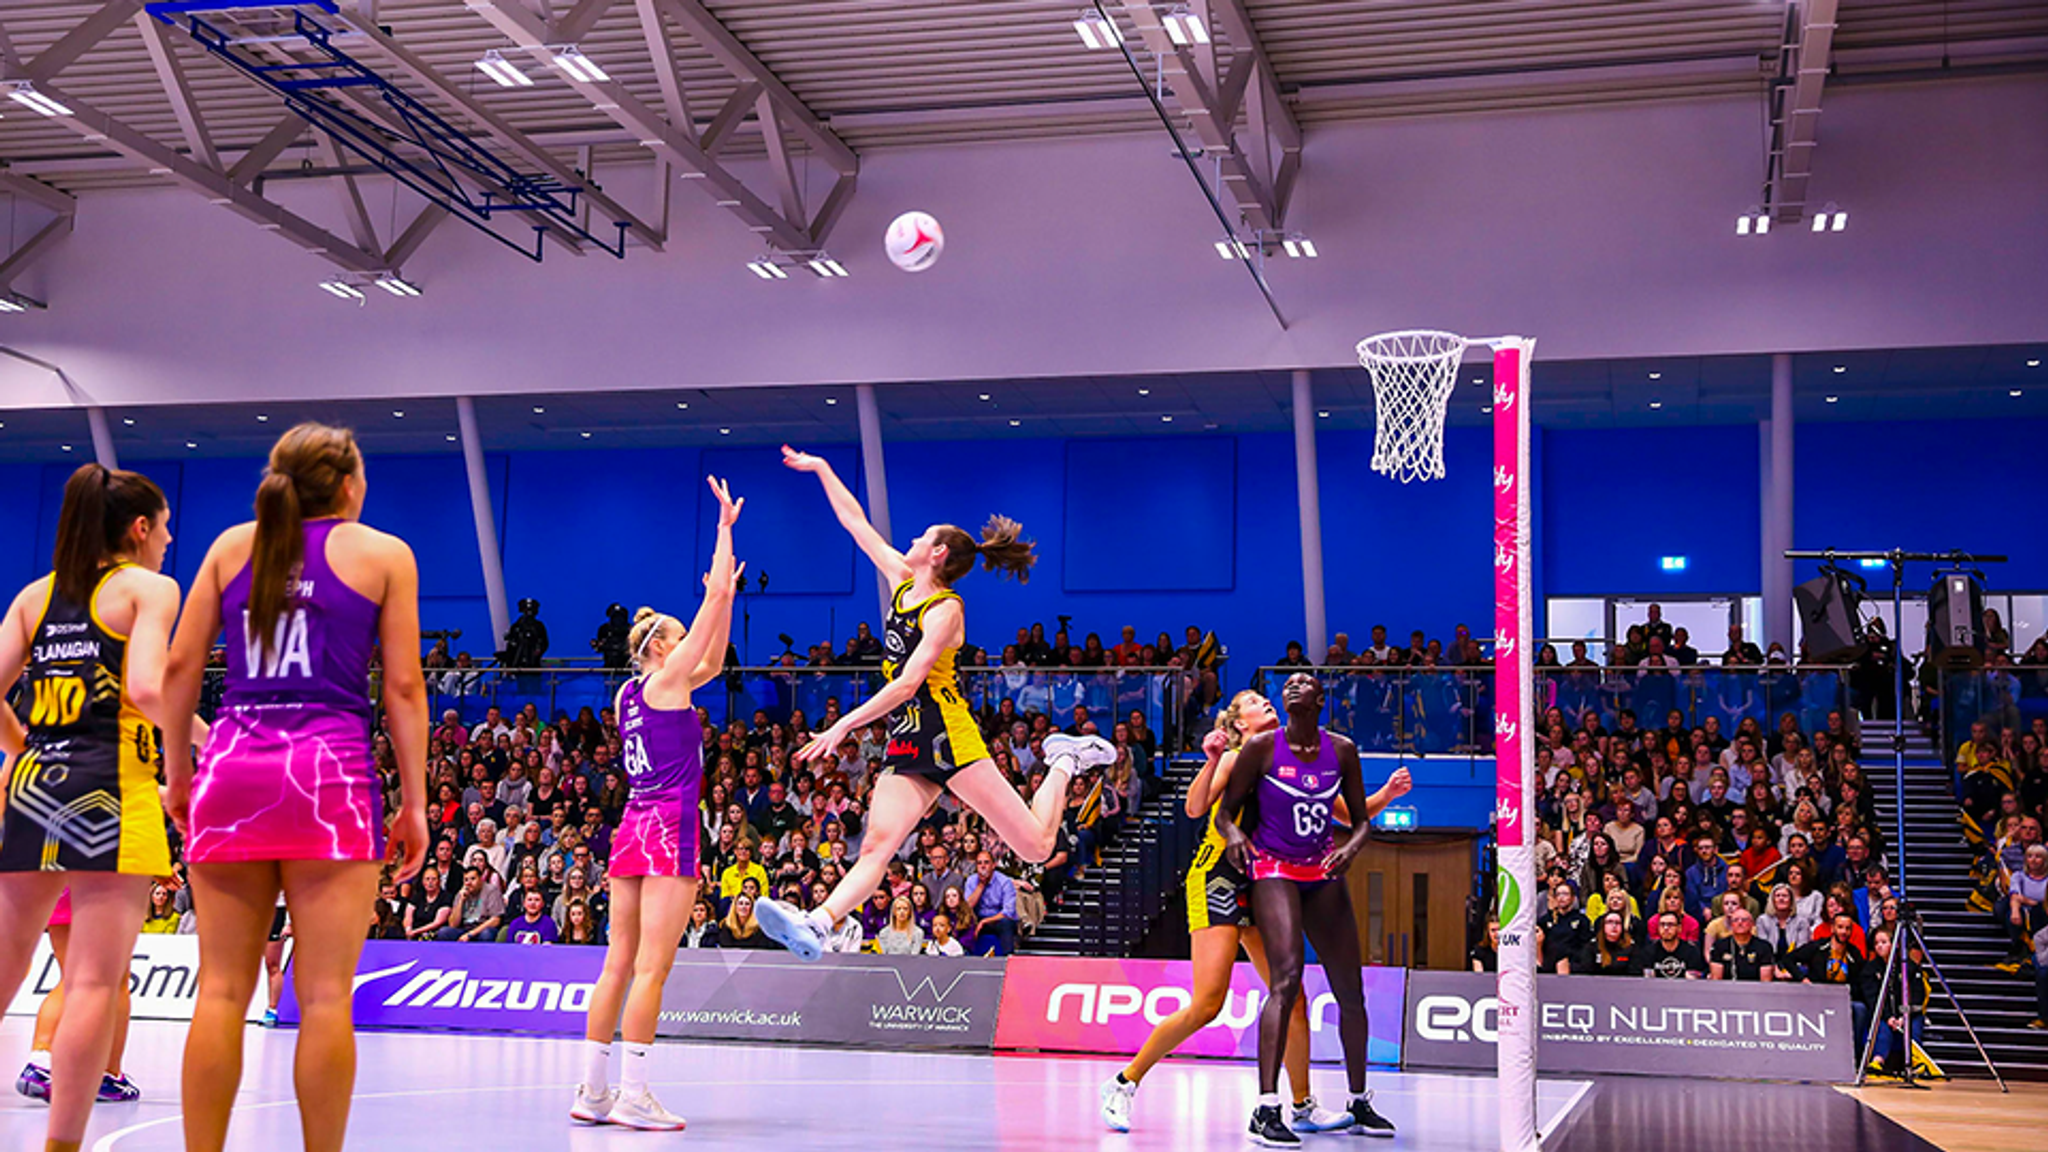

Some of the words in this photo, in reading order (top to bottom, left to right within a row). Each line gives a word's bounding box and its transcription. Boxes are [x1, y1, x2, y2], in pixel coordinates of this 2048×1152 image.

[242, 608, 313, 679] WA
[29, 676, 87, 727] WD
[624, 733, 653, 777] GA
[1292, 802, 1329, 837] GS
[382, 968, 597, 1012] MIZUNO
[872, 1004, 972, 1023] WARWICK
[1542, 1003, 1595, 1033] EQ
[1542, 1034, 1595, 1042] INSPIRED
[1759, 1040, 1775, 1049] TO
[1777, 1042, 1827, 1051] QUALITY
